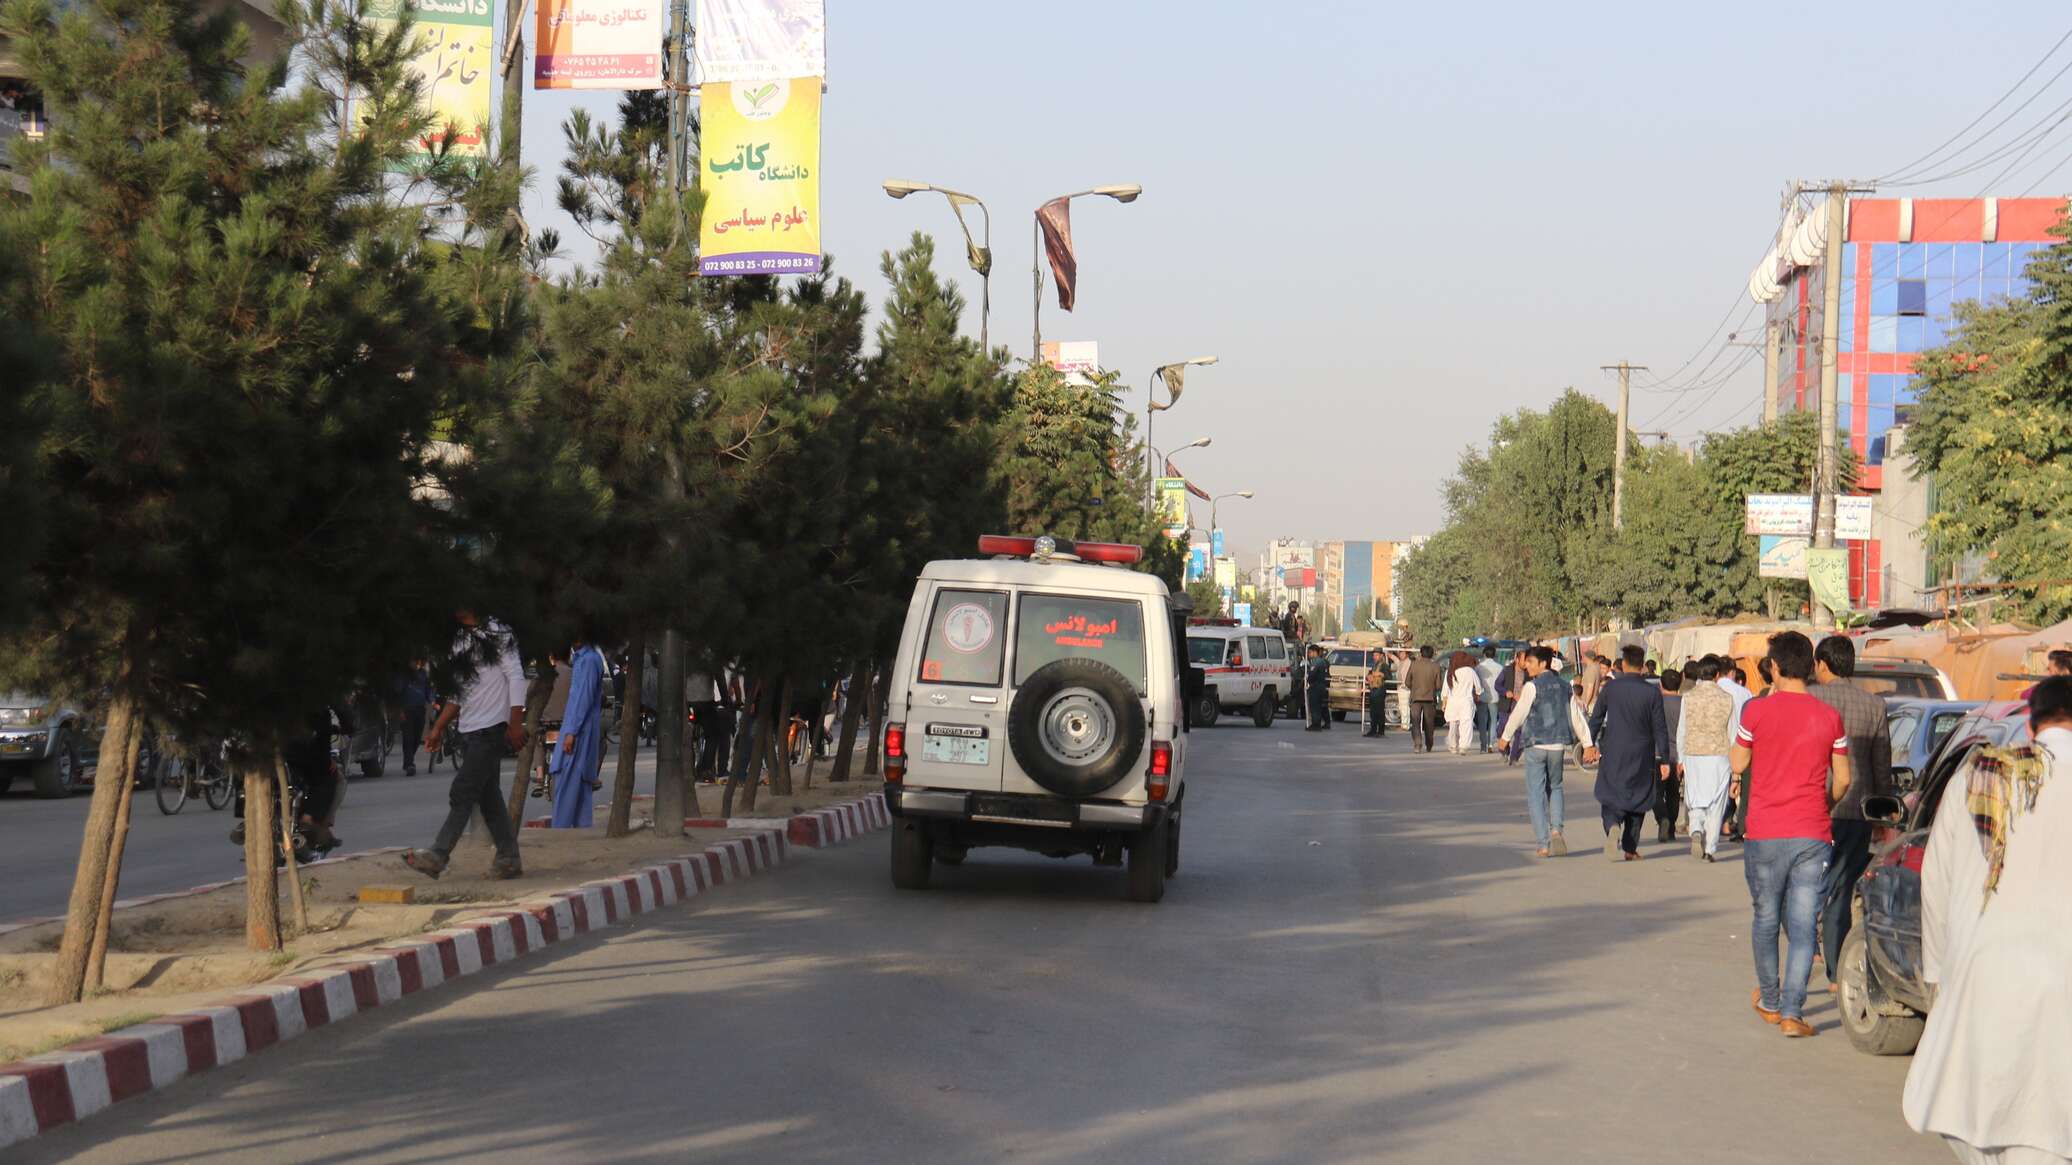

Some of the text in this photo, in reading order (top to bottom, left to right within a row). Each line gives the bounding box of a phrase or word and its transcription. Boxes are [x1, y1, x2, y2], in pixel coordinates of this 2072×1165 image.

[709, 143, 809, 181] دانشگاه کاتب
[714, 206, 808, 234] علوم سیاسی
[704, 262, 719, 271] 072
[720, 261, 734, 270] 900
[746, 260, 756, 269] 25
[761, 259, 775, 269] 072
[777, 259, 791, 268] 900
[792, 258, 802, 267] 83
[803, 257, 814, 266] 26
